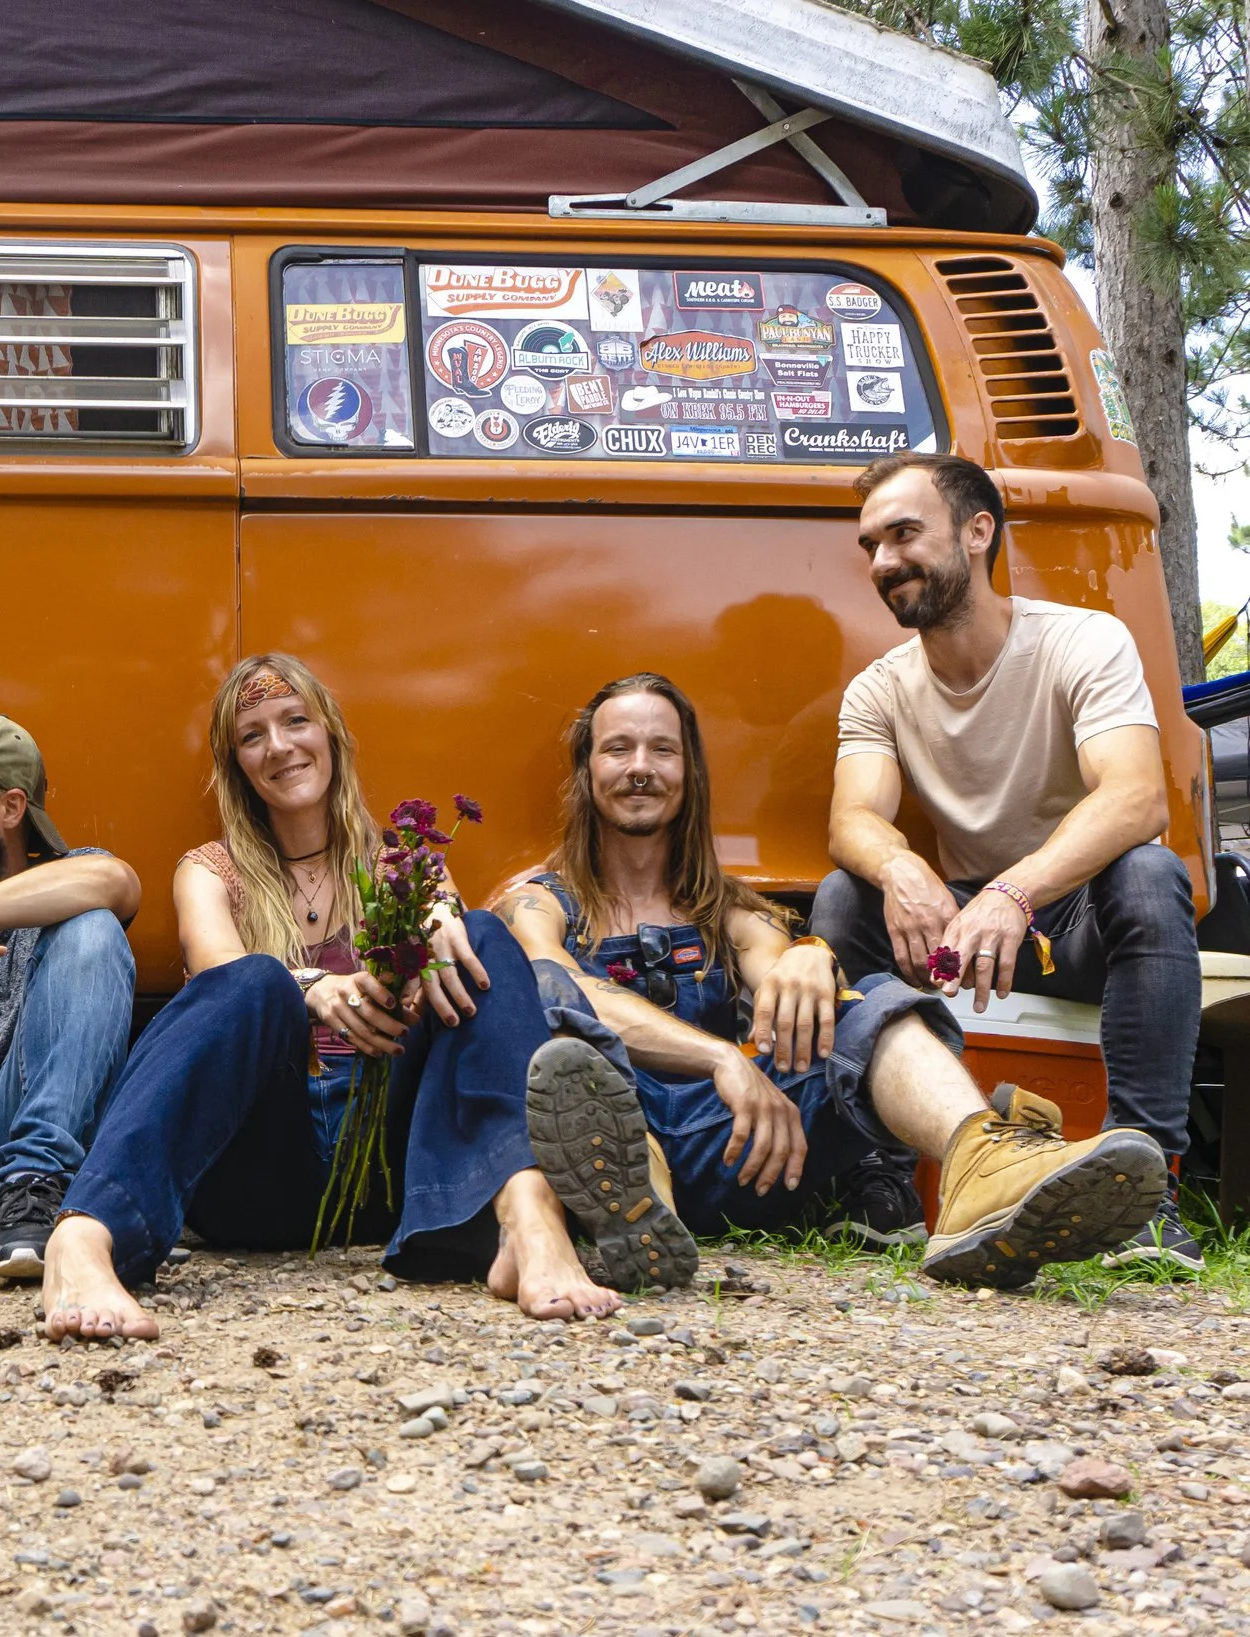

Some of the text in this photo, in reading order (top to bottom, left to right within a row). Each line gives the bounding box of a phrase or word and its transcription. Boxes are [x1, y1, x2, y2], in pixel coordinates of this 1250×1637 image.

[447, 293, 556, 303] SUPPLY COMPANY
[828, 296, 879, 308] S.S. BADGER
[303, 324, 339, 334] SUPPLY
[851, 330, 891, 344] HAPPY
[432, 325, 464, 357] MINNESOTA'S
[465, 325, 498, 344] COUNTRY
[494, 343, 504, 370] LEGEND
[645, 341, 683, 365] Alex
[685, 341, 752, 361] Williams
[847, 344, 901, 359] TRUCKER
[300, 349, 381, 364] STIGMA
[559, 355, 584, 367] ROCK
[576, 378, 604, 396] BENT
[719, 403, 745, 421] 95.5
[779, 401, 826, 409] HAMBURGERS
[607, 429, 662, 452] CHUX
[676, 435, 736, 450] J4V 1ER
[746, 435, 775, 445] DEN
[784, 427, 908, 453] Crankshaft
[747, 444, 776, 454] REC
[1002, 884, 1035, 925] FESTIVA
